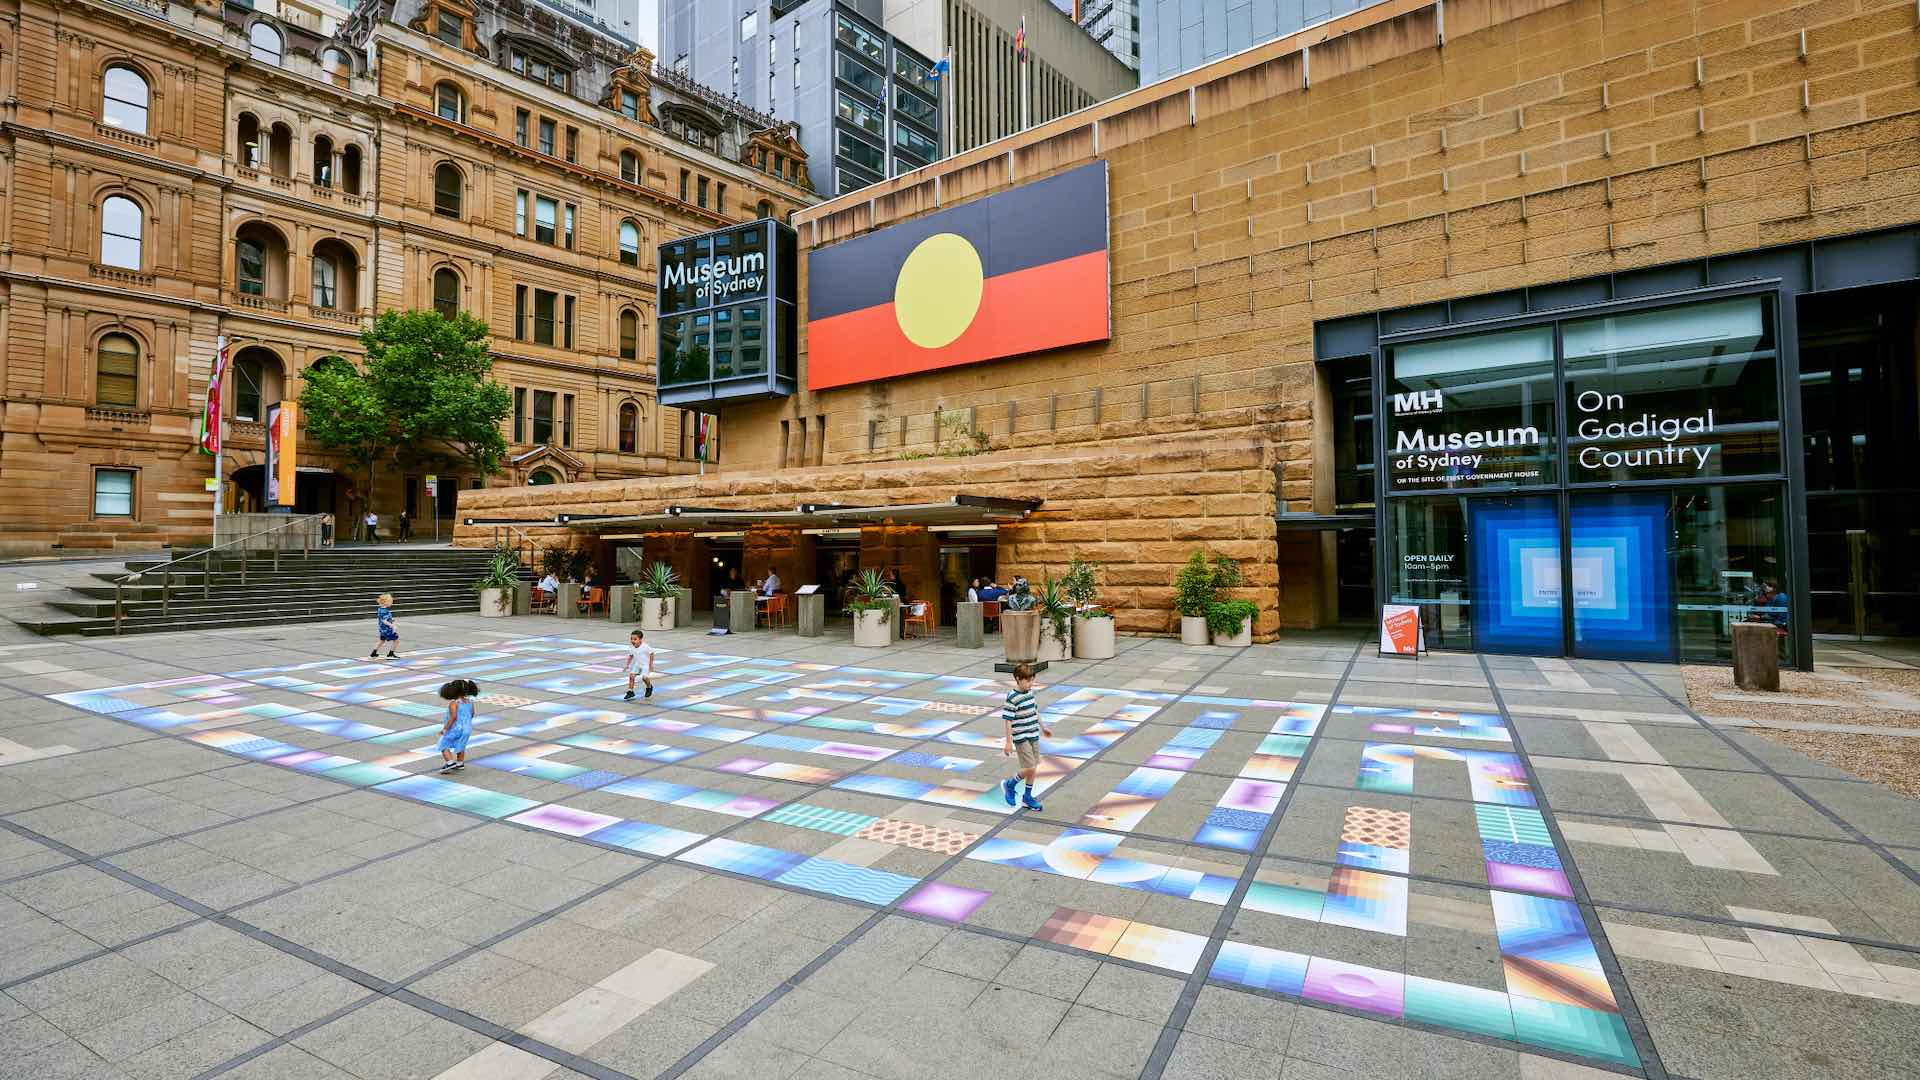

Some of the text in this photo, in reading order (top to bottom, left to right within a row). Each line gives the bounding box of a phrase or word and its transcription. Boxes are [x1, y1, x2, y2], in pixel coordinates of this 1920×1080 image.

[664, 252, 765, 289] Museum
[695, 275, 764, 298] of Sydney
[1394, 389, 1443, 413] MH
[1577, 390, 1624, 413] On
[1578, 408, 1714, 442] Gadigal
[1396, 425, 1539, 453] Museum
[1396, 452, 1483, 471] of Sydney
[1579, 443, 1713, 470] Country
[1465, 472, 1513, 480] GOVERNMENT
[1514, 470, 1539, 478] HOUSE
